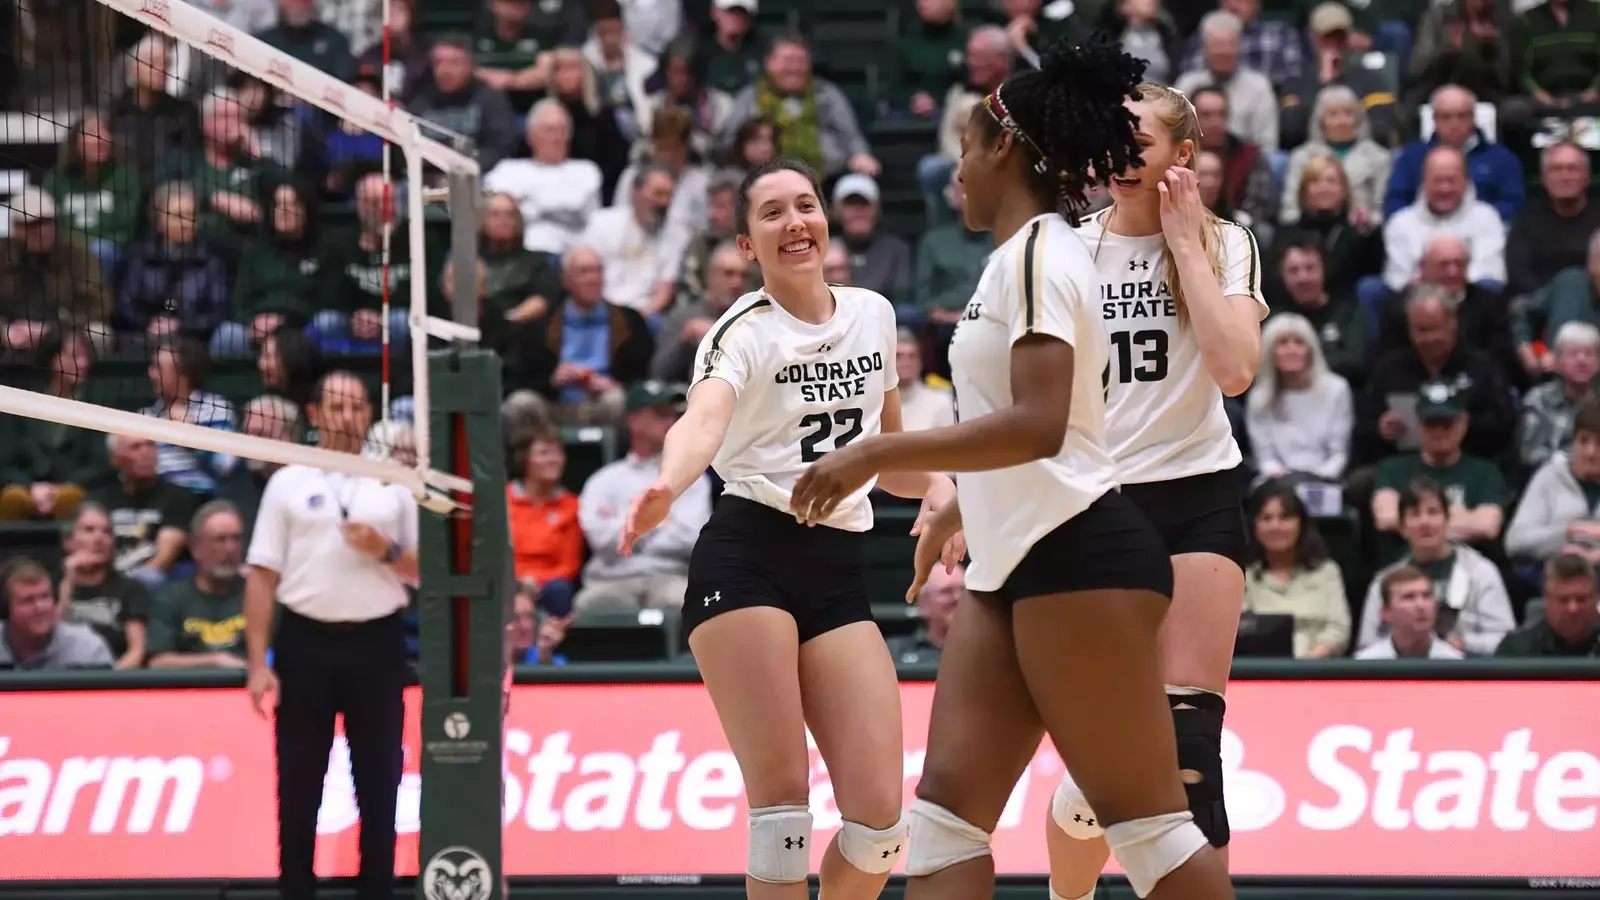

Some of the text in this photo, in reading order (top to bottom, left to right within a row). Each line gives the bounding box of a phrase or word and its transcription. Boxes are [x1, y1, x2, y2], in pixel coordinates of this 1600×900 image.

[1101, 280, 1172, 300] LORA
[1102, 299, 1177, 320] STATE
[775, 351, 883, 384] COLORADO
[1110, 329, 1169, 384] 13
[800, 376, 866, 402] STATE
[798, 407, 864, 463] 22
[0, 736, 204, 836] arm
[1296, 724, 1600, 831] State
